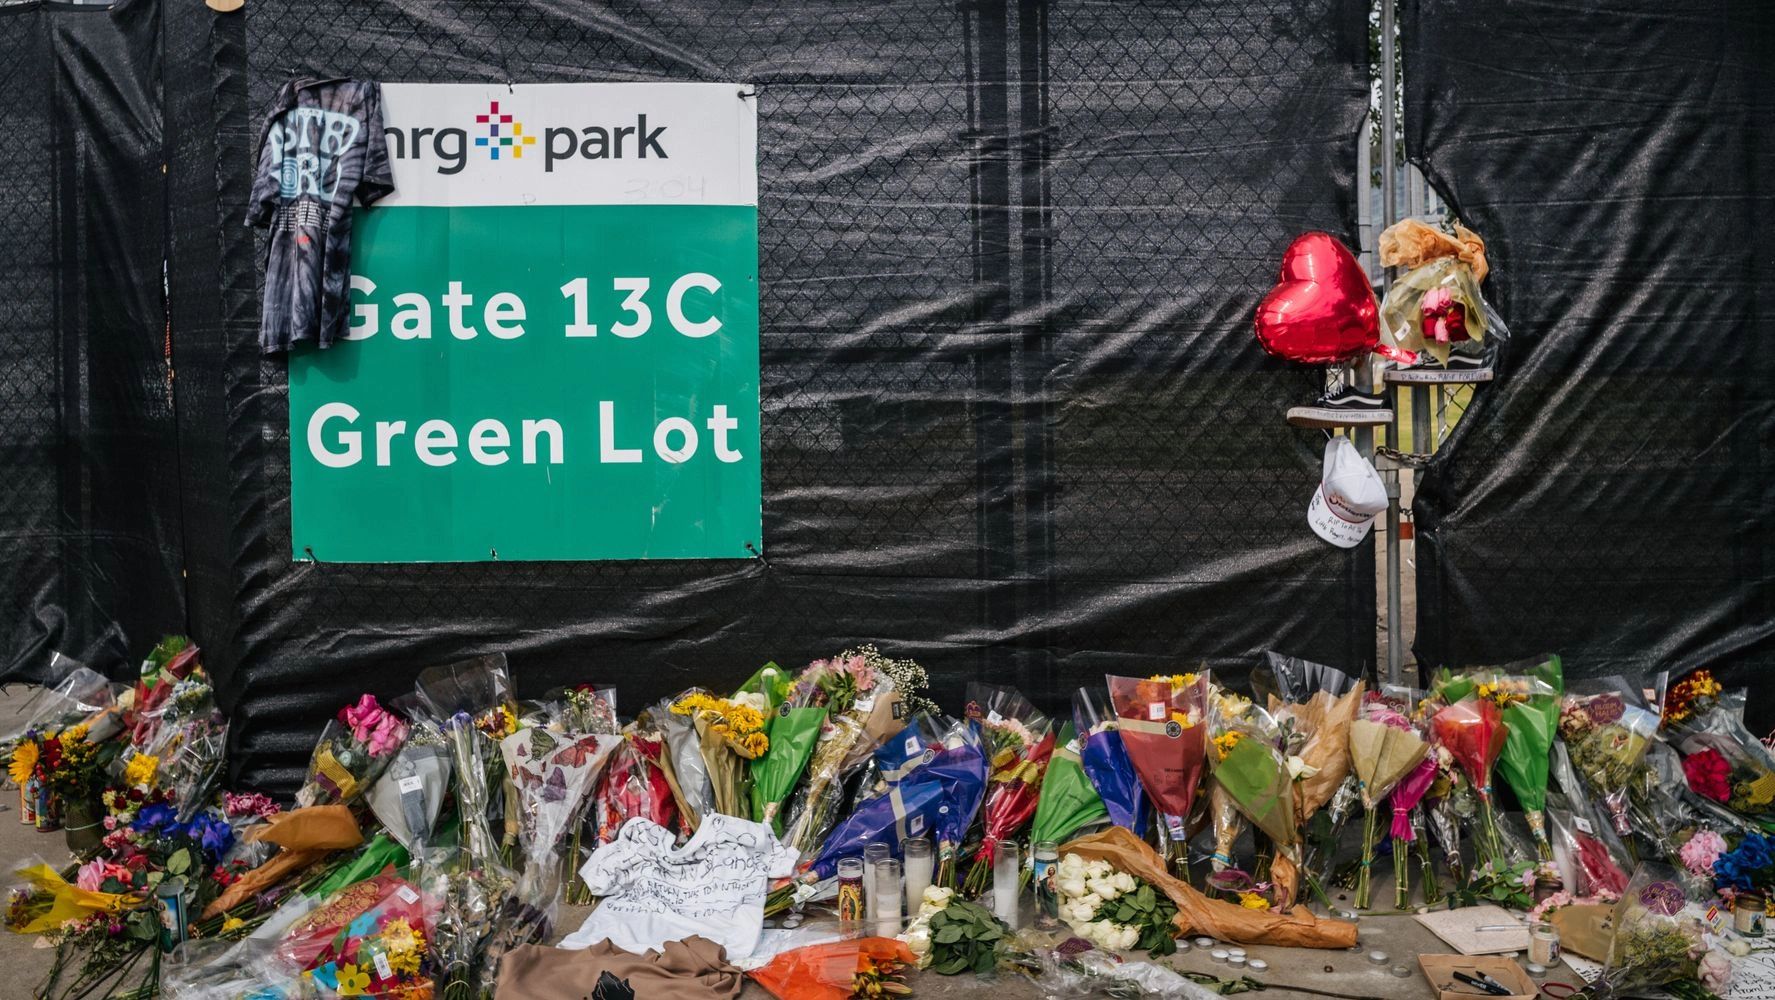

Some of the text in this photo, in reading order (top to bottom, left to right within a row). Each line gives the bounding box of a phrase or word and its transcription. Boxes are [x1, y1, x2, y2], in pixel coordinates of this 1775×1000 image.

[545, 114, 669, 172] park
[348, 272, 723, 340] Gate 13C
[306, 400, 743, 468] Green Lot
